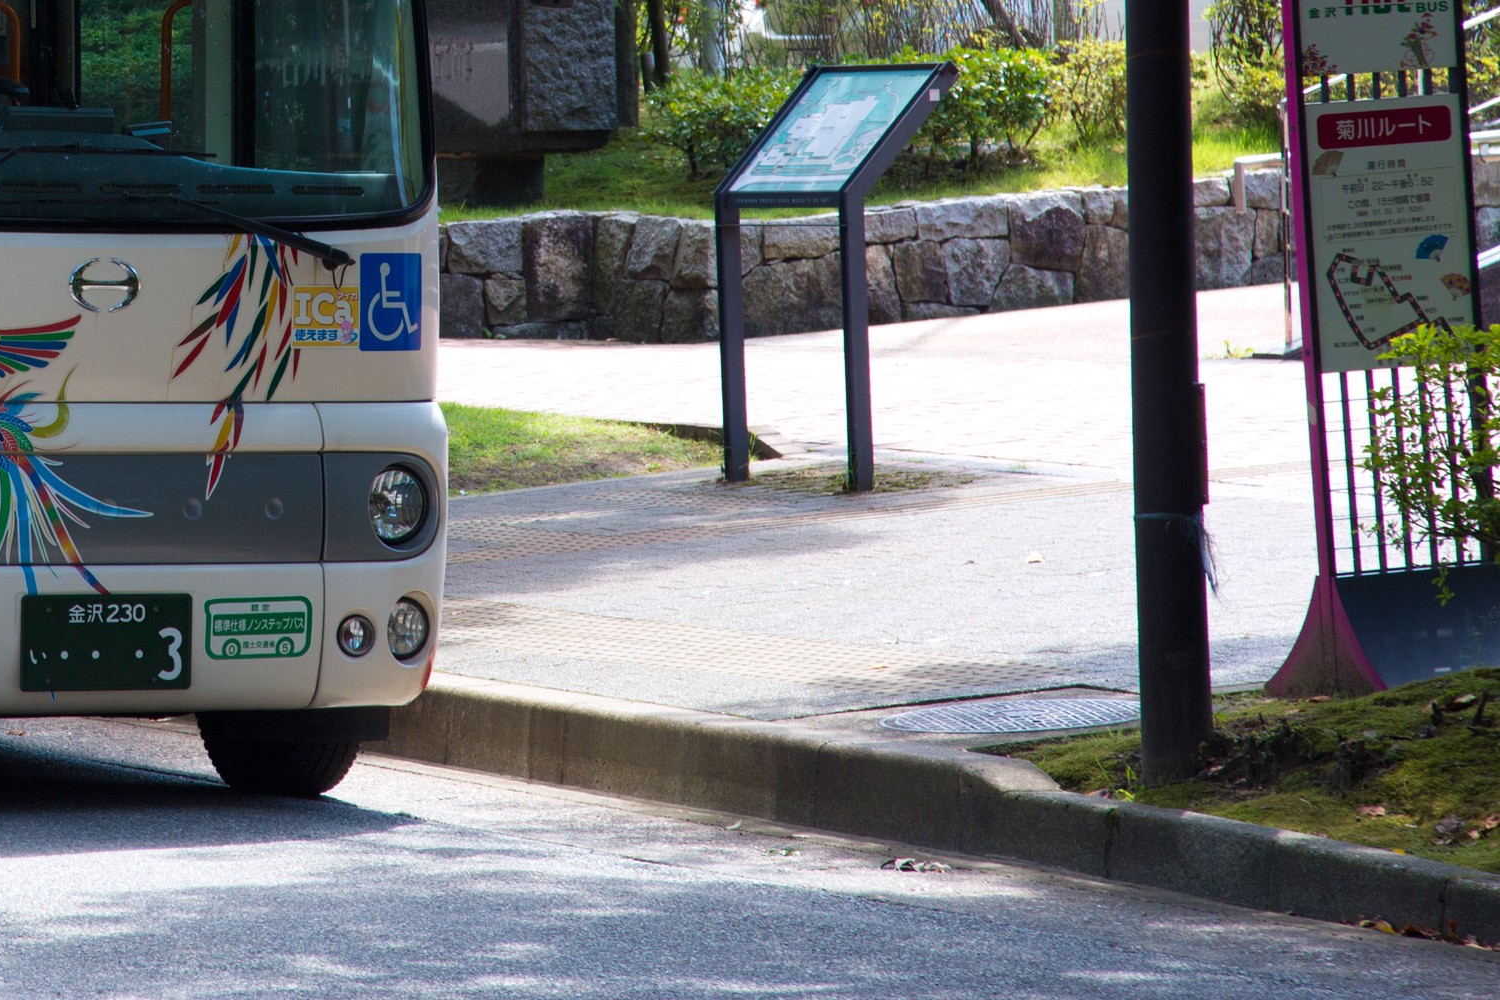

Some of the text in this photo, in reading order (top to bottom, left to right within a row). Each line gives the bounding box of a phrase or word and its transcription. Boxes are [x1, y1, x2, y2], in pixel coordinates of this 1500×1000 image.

[1309, 0, 1449, 19] 金沢 BUS
[1336, 114, 1432, 141] 菊川ルート
[337, 292, 358, 301] アイカ
[294, 291, 355, 326] ICa
[295, 329, 339, 341] 使えます
[68, 603, 146, 624] 金沢230
[250, 603, 270, 612] 認定
[242, 640, 276, 649] 国土交通省
[281, 643, 289, 653] 5
